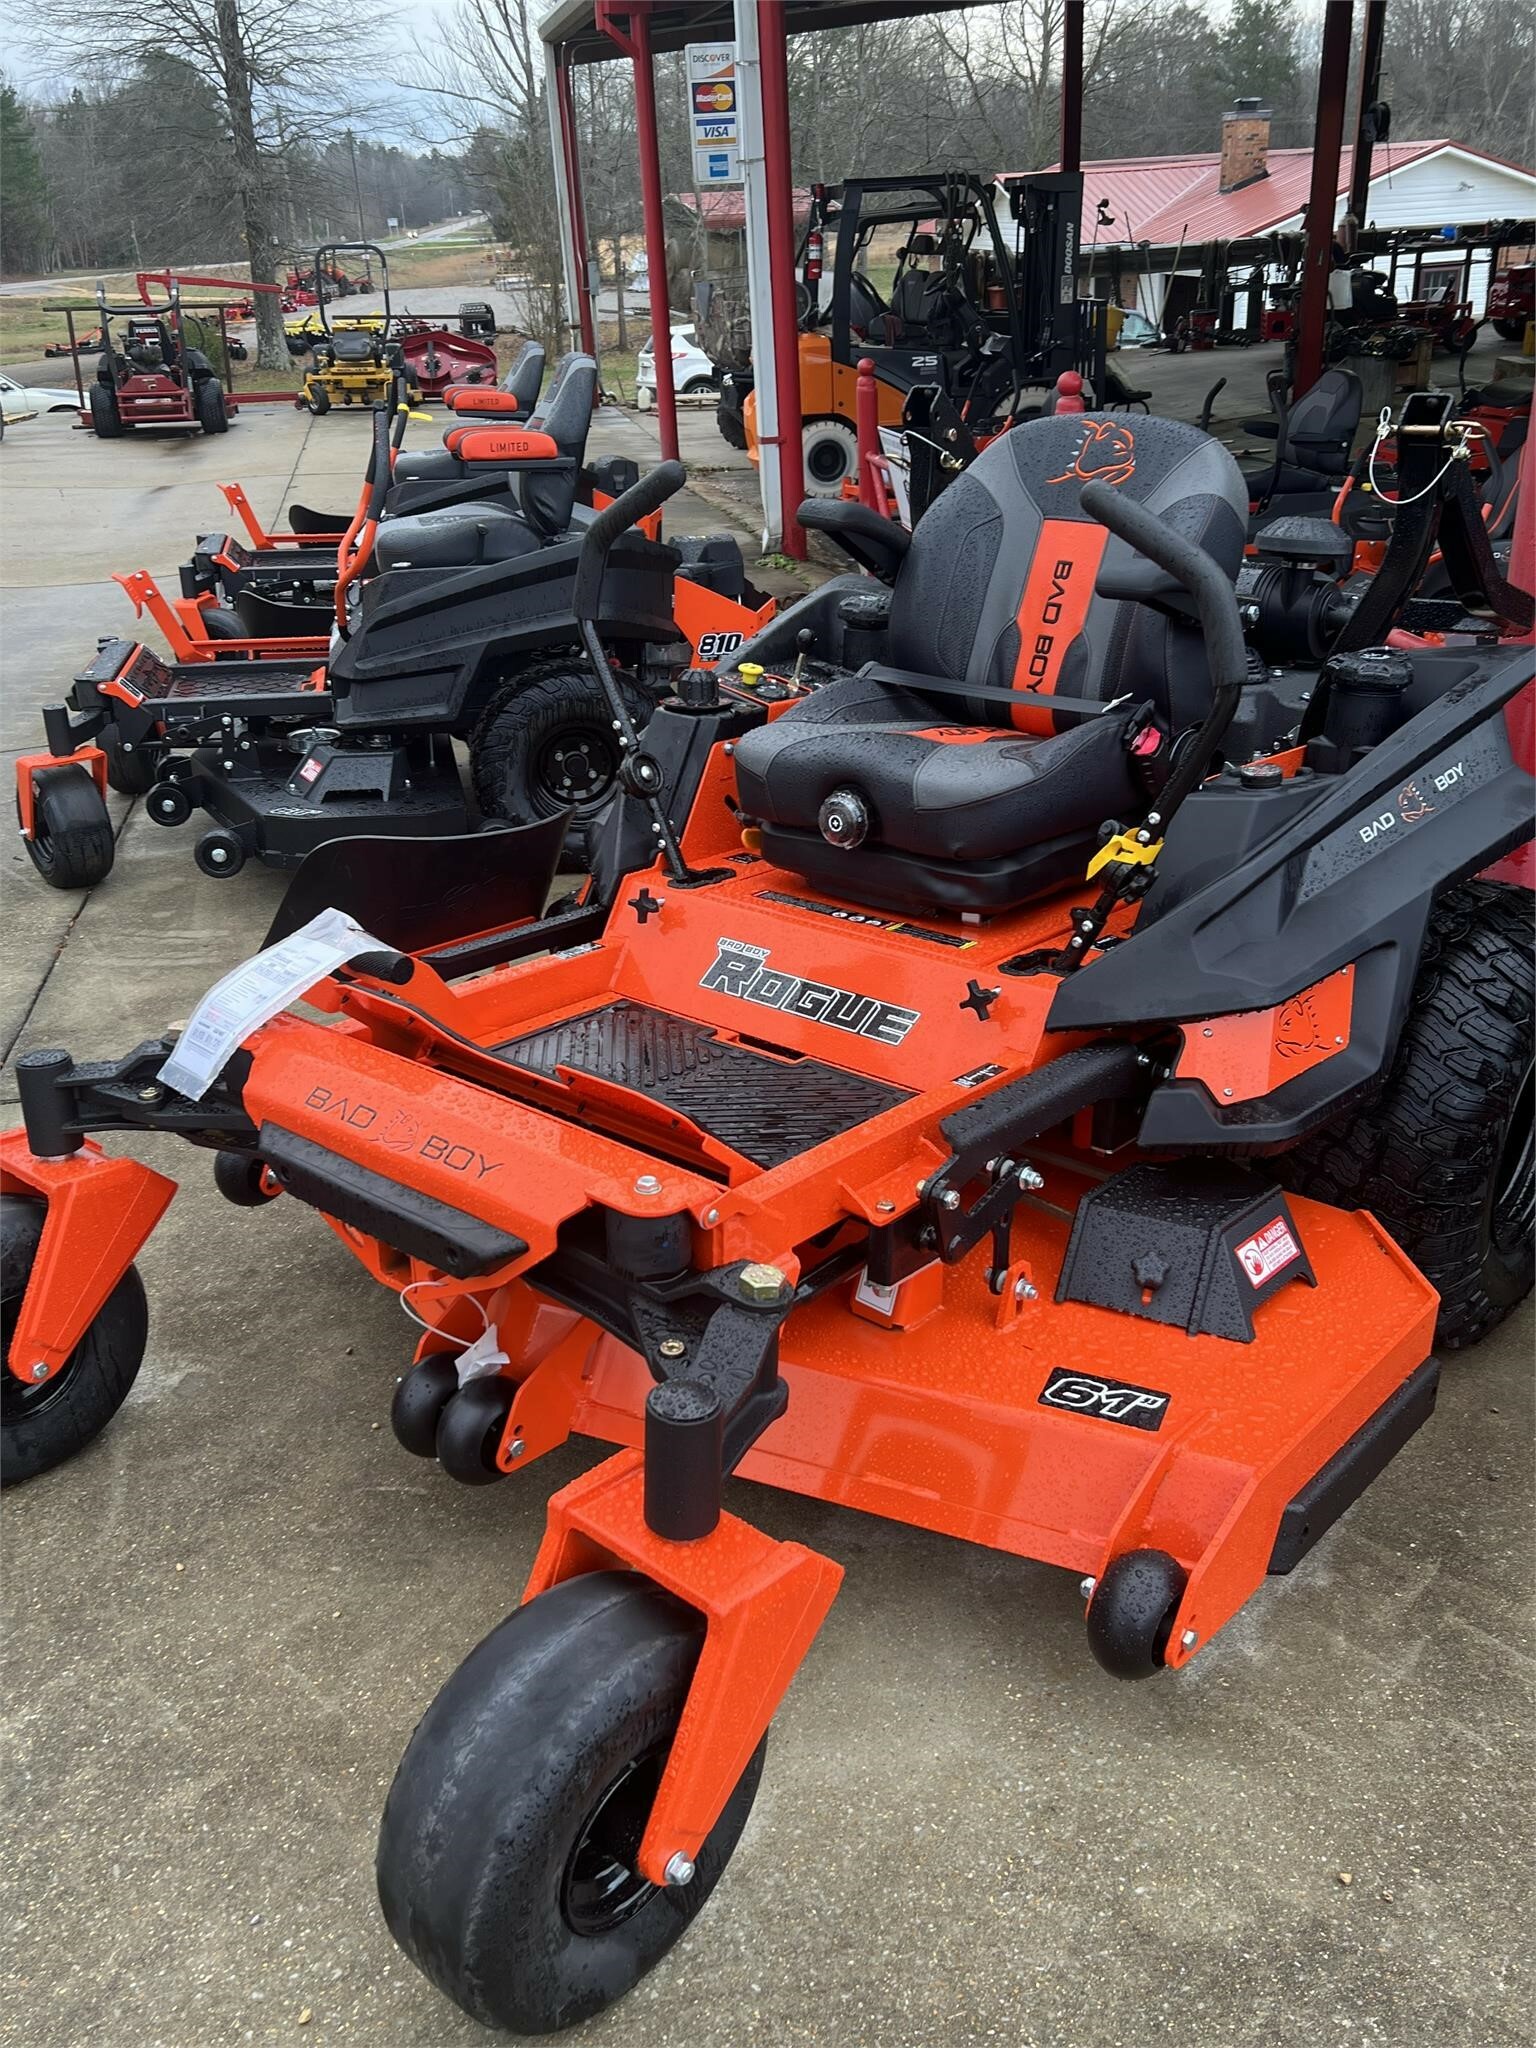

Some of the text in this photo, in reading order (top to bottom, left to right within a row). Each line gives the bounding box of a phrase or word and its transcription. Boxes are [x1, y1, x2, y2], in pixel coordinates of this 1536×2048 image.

[693, 53, 730, 63] DISCOVER
[704, 126, 729, 138] VISA
[1064, 222, 1075, 274] DOOSAN
[911, 355, 938, 367] 25
[473, 398, 500, 406] LIMITED
[490, 441, 529, 453] LIMITED
[1026, 560, 1074, 694] BAD BOY
[698, 632, 744, 656] 810
[1359, 762, 1464, 843] BAD BOY
[719, 938, 769, 957] BAD BOY
[699, 946, 921, 1046] ROGUE
[304, 1086, 505, 1180] BAD BOY
